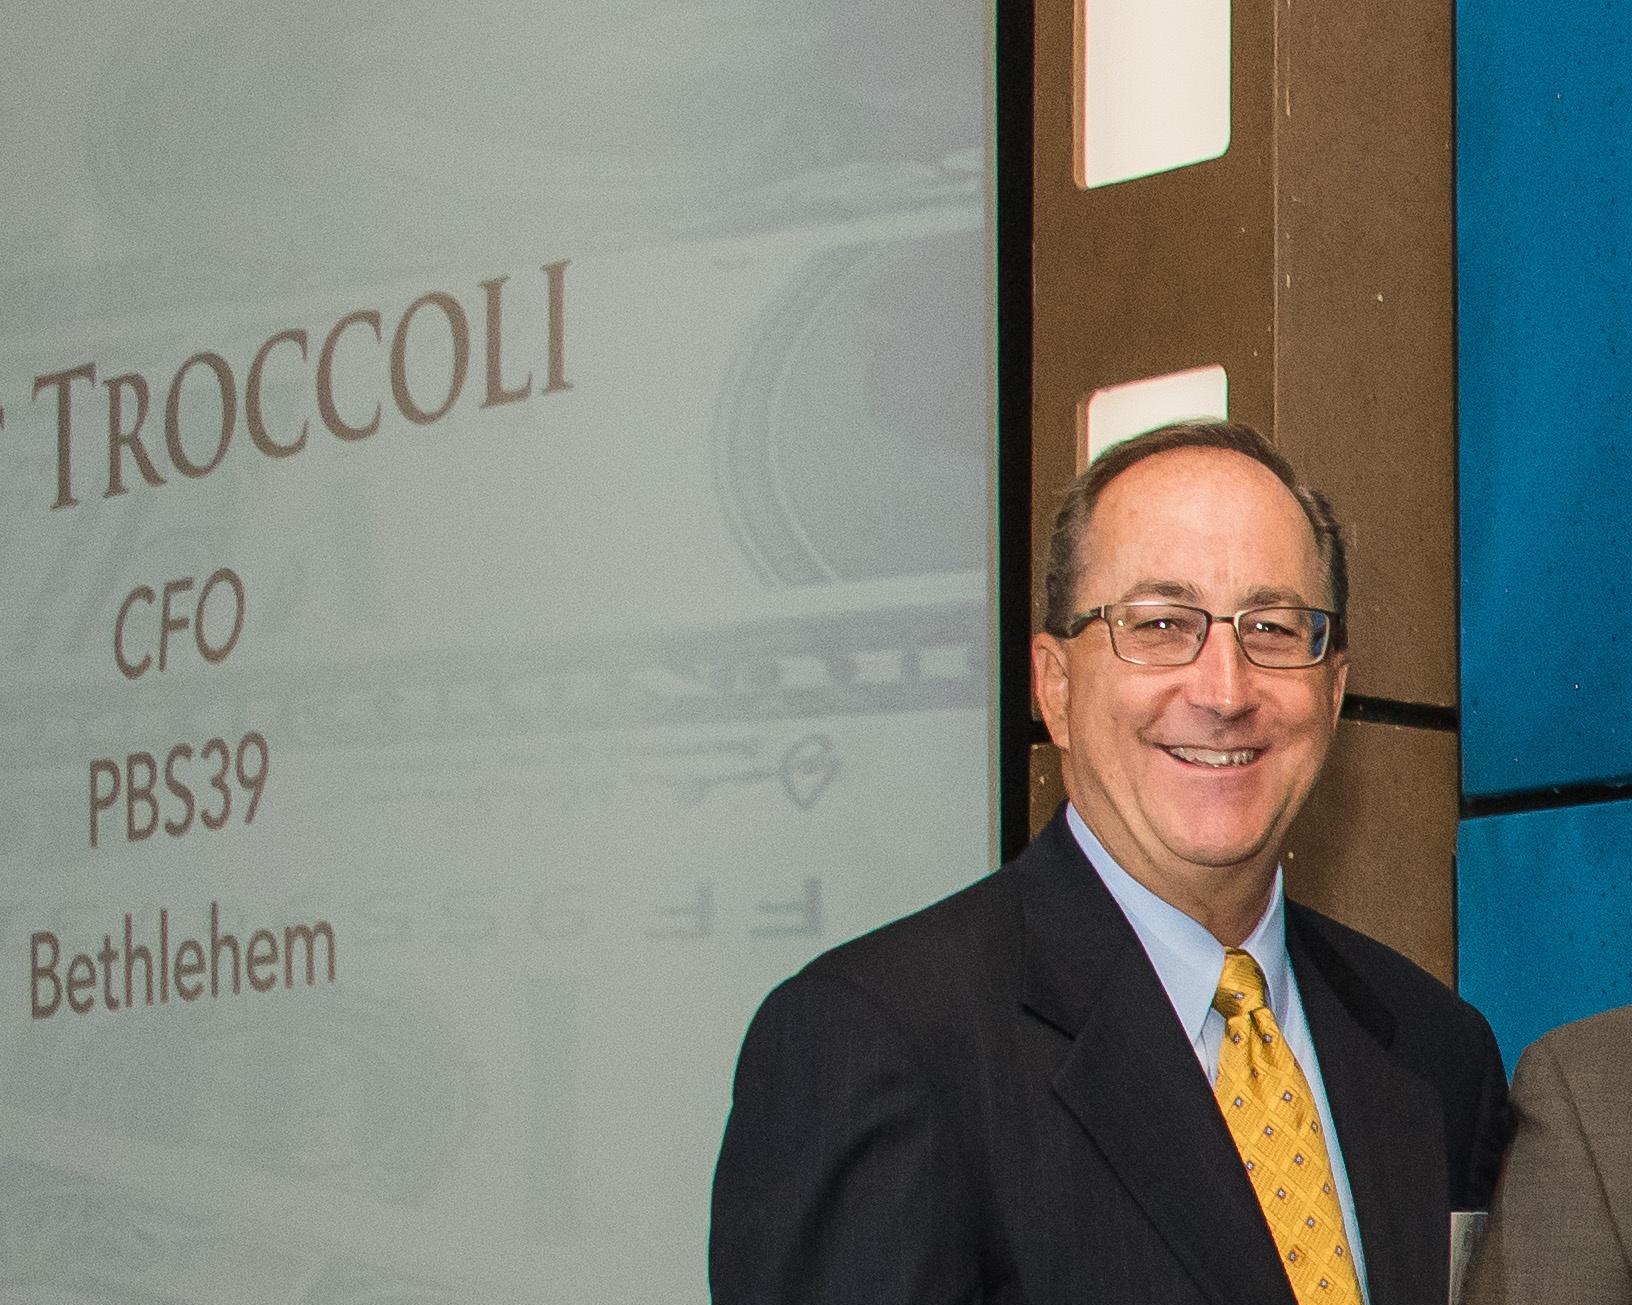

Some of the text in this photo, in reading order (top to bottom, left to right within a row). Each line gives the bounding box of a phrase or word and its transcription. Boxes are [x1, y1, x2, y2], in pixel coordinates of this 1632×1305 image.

[31, 259, 575, 510] TROCCOLI
[113, 566, 246, 680] CFO
[89, 730, 270, 848] PBS39
[29, 901, 337, 1021] Bethlehem
